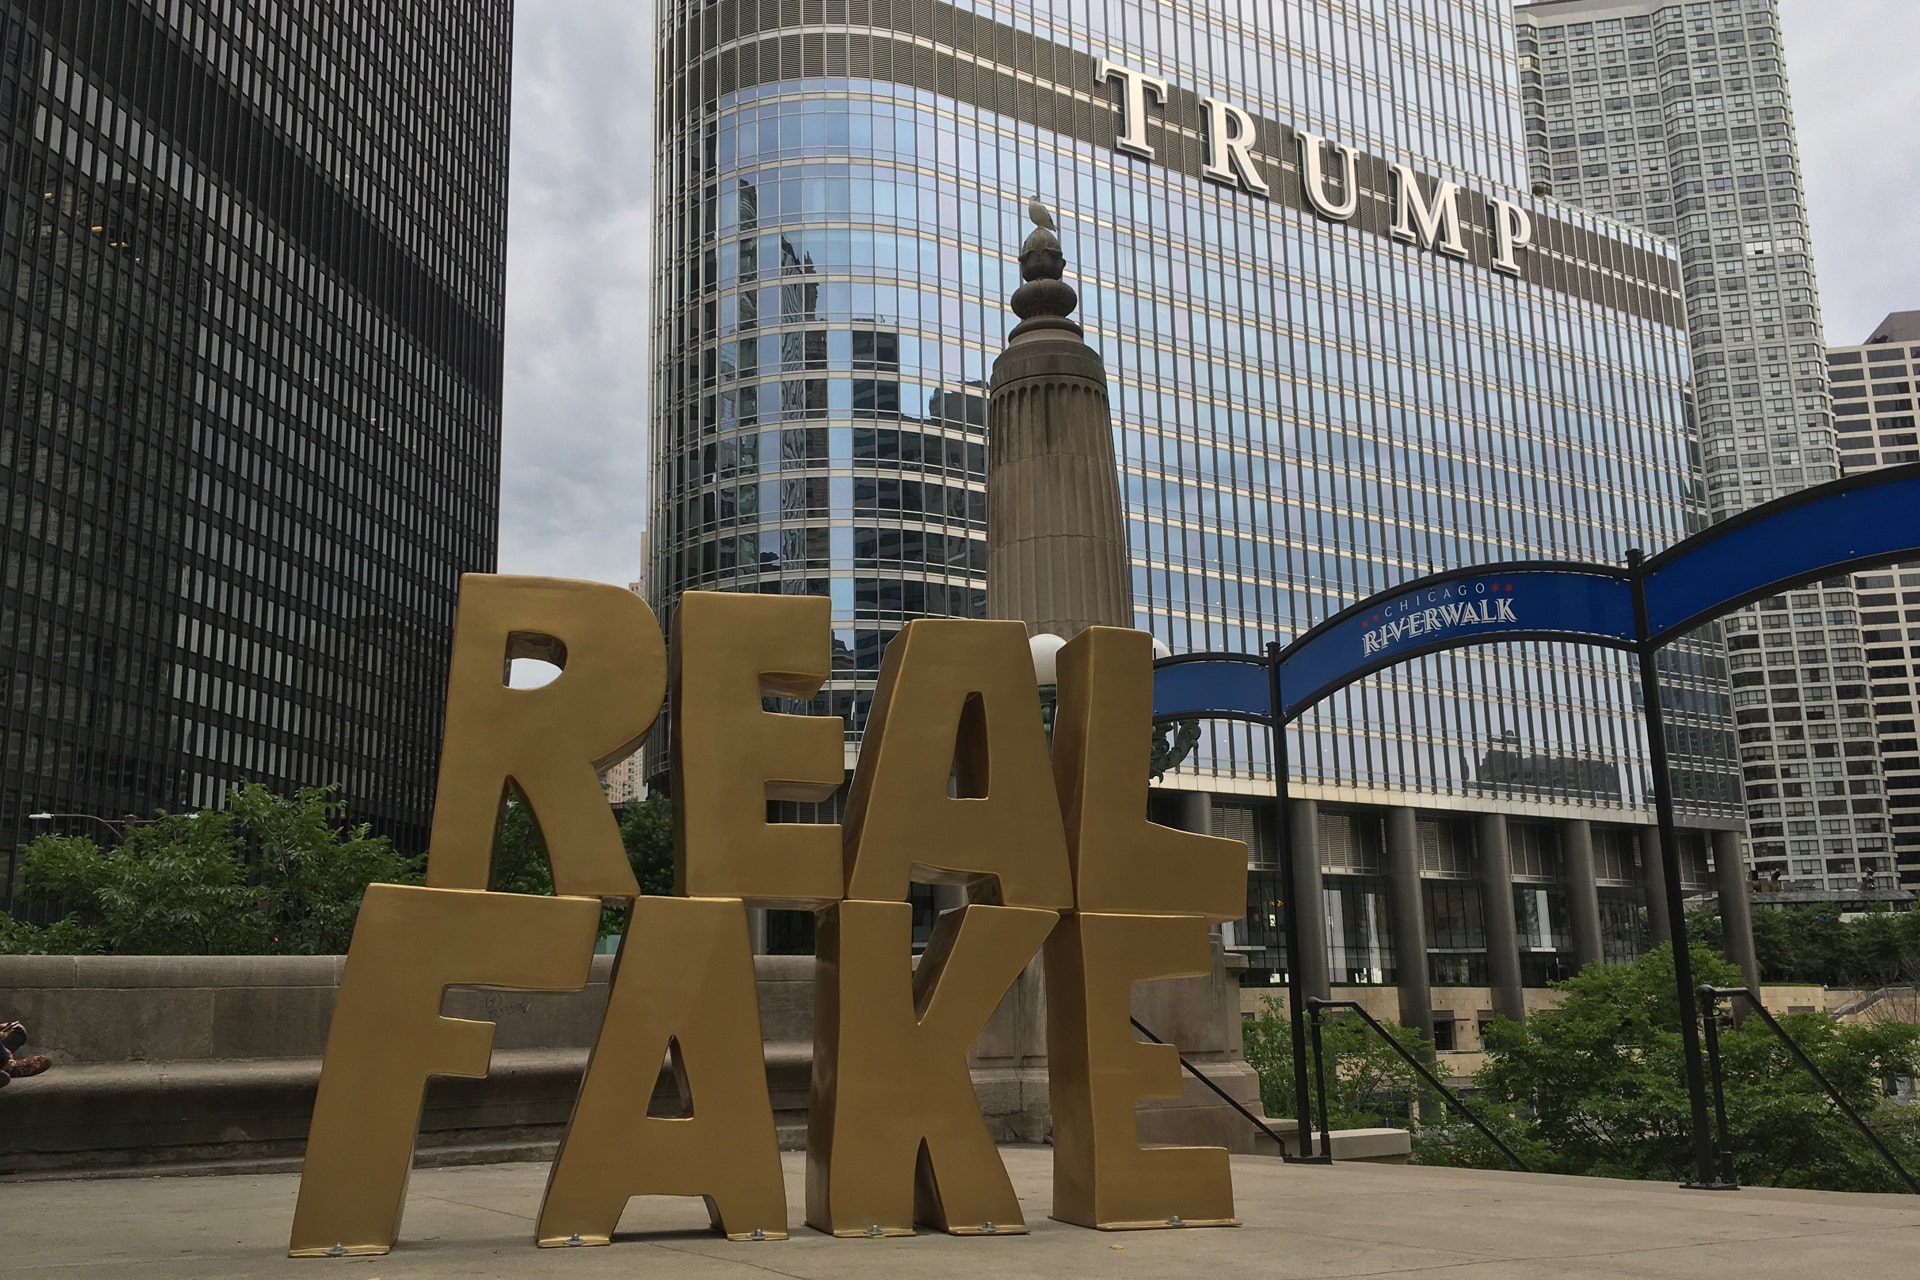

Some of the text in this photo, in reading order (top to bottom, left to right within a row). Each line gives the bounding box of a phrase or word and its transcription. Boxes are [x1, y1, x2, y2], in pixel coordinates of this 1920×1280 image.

[1095, 56, 1534, 276] TRUMP
[1361, 598, 1518, 658] RIVERWALK
[1384, 582, 1485, 617] CHICAGO
[426, 571, 1249, 917] REAL
[288, 883, 1243, 1258] FAKE
